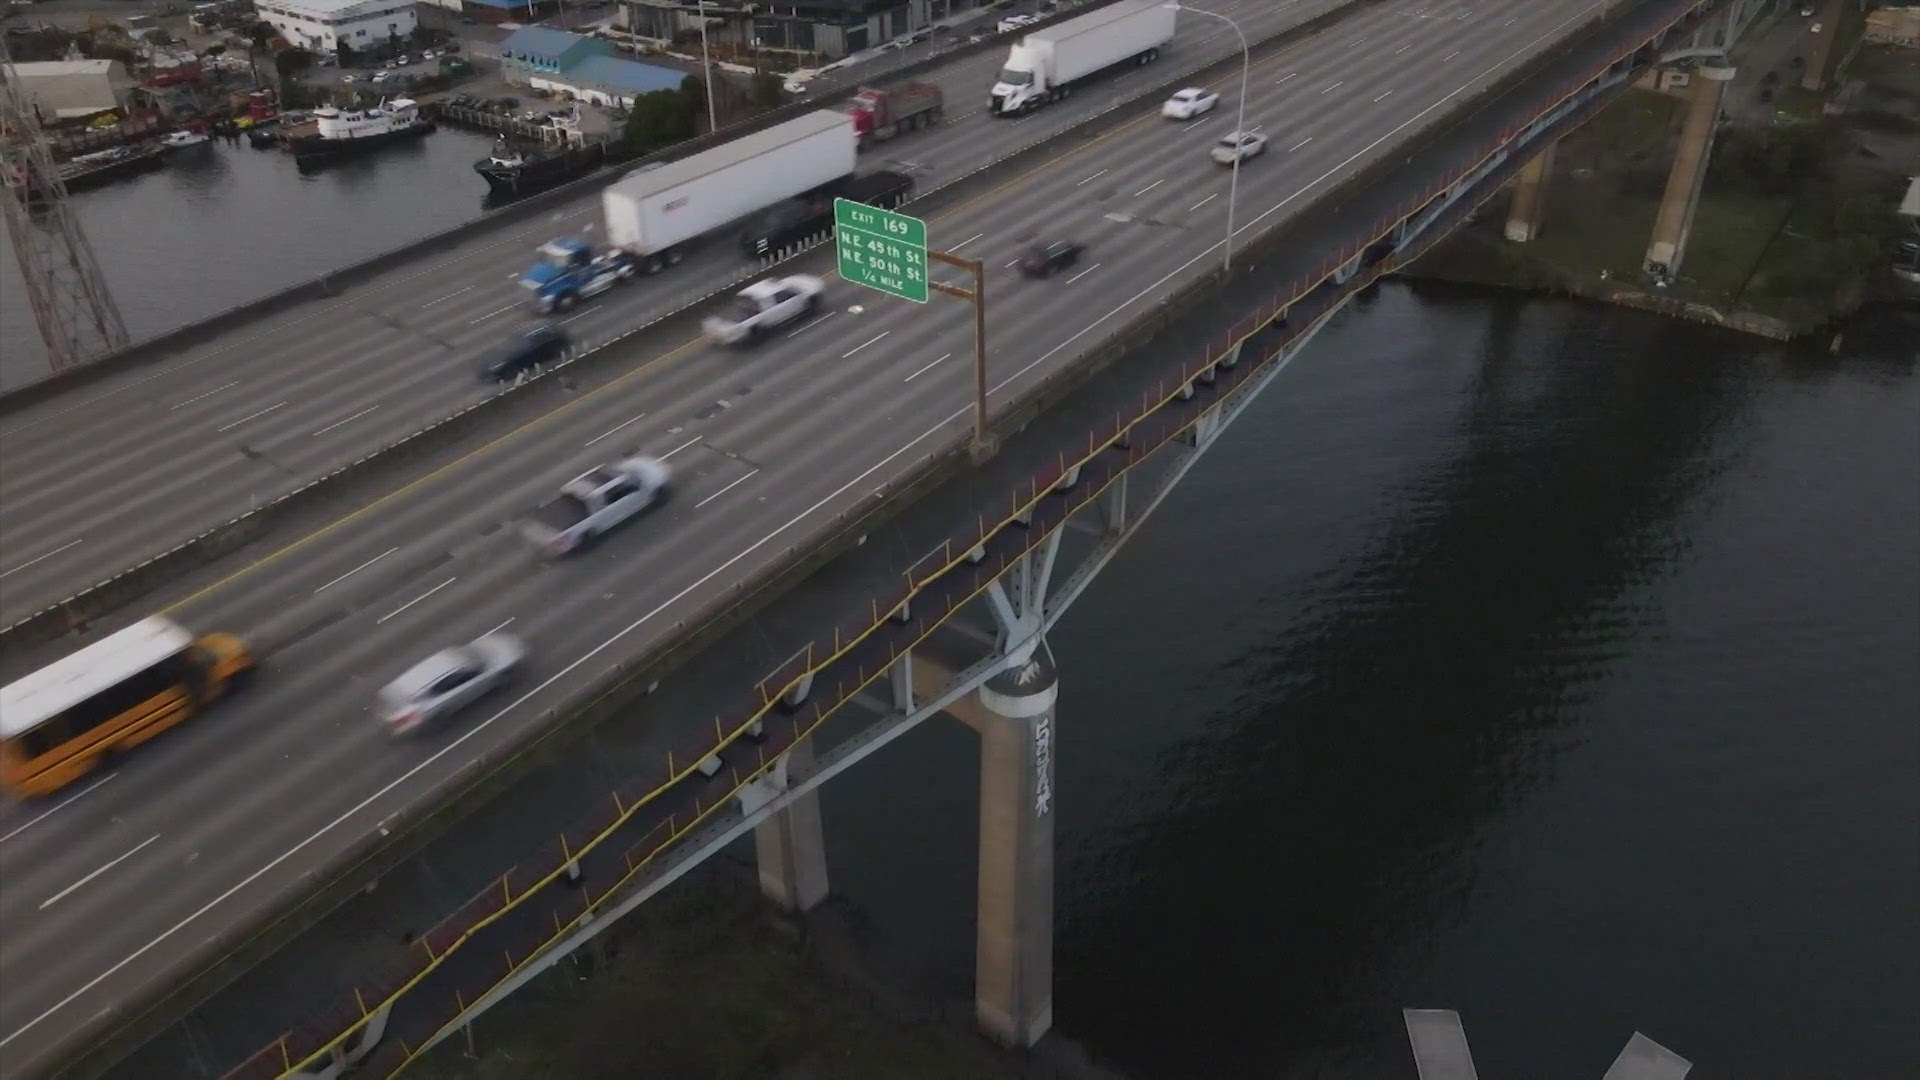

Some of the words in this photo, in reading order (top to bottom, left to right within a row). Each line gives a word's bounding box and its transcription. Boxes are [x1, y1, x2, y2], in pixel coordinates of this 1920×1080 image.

[851, 210, 874, 224] EXIT
[883, 216, 908, 234] 169
[867, 240, 900, 258] 45th
[869, 256, 900, 275] 50th
[880, 275, 903, 290] MILE
